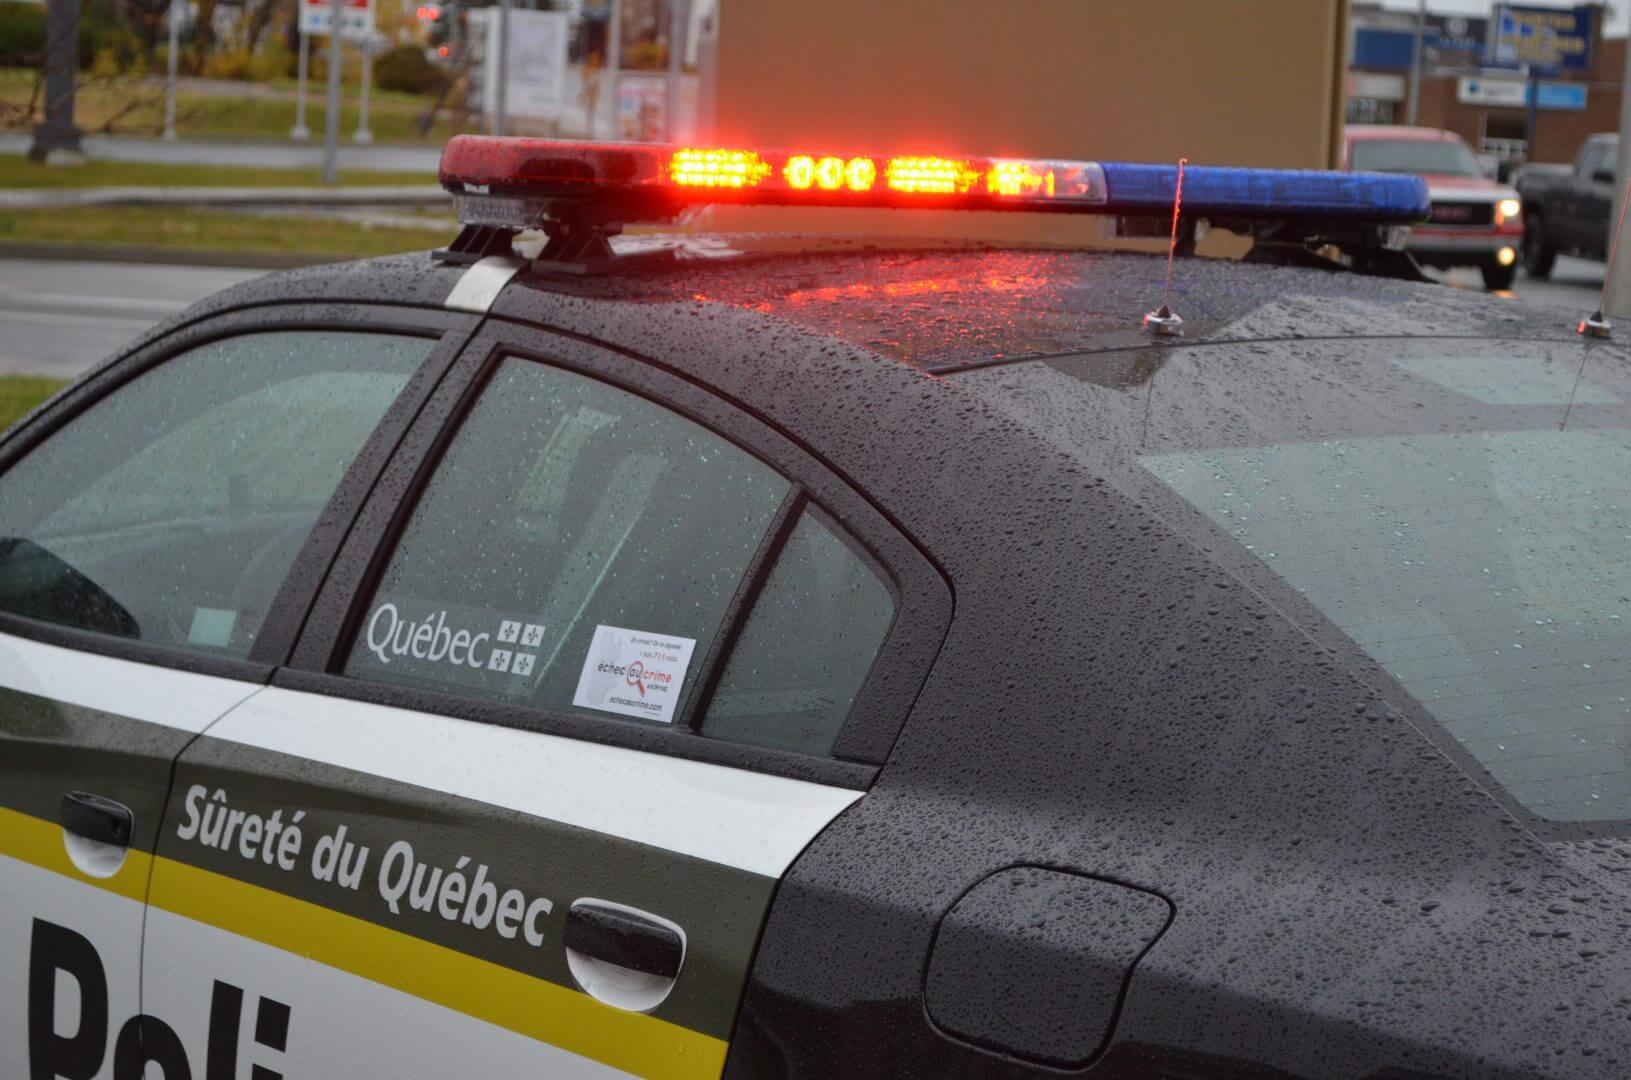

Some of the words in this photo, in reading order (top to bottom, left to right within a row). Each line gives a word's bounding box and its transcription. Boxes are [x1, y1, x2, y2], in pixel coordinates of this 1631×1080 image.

[367, 602, 490, 668] Québec
[629, 668, 642, 679] au
[643, 670, 672, 684] crime
[176, 784, 306, 871] Sûreté
[311, 824, 370, 891] du
[378, 841, 554, 948] Québec
